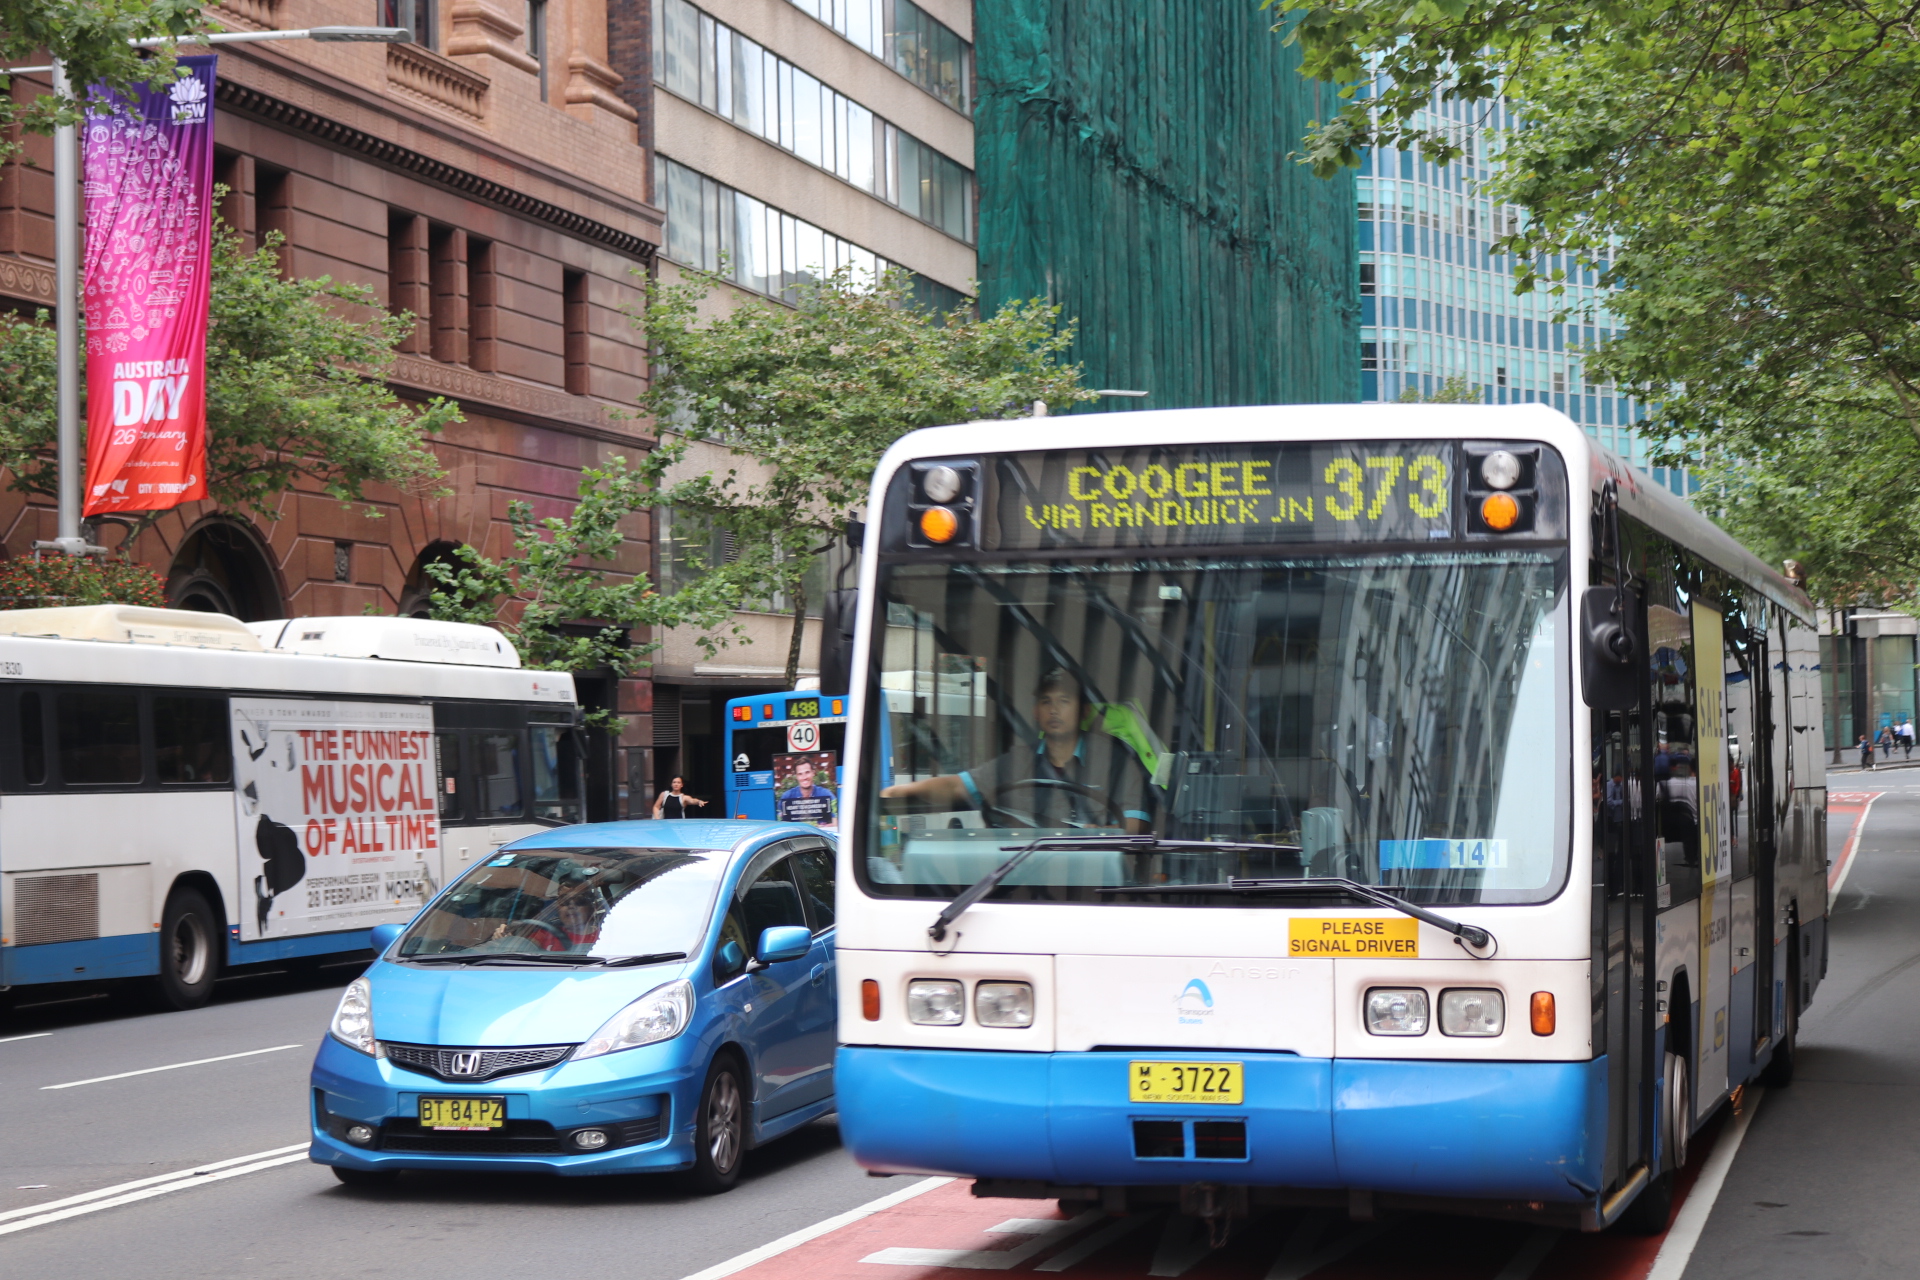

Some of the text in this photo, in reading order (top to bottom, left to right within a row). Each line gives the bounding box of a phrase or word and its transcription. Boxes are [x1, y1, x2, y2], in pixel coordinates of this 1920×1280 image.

[171, 102, 207, 120] NSW
[113, 358, 189, 379] AUSTRALIA
[113, 375, 189, 427] DAY
[113, 428, 136, 446] 26
[1068, 460, 1272, 501] COOGEE
[1324, 454, 1447, 522] 373
[1025, 496, 1313, 530] VIA RANDWICK JN
[789, 701, 819, 718] 438
[1700, 686, 1724, 738] SALE
[298, 729, 430, 761] THE FUNNIEST
[793, 727, 815, 743] 40
[301, 762, 435, 815] MUSICAL
[305, 814, 438, 857] OF ALL TIME
[1457, 841, 1500, 866] 141
[323, 884, 381, 906] FEBRUARY
[1322, 922, 1385, 936] PLEASE
[1290, 939, 1416, 953] SIGNAL DRIVER
[1207, 961, 1301, 980] Ansair
[1177, 1007, 1215, 1017] Transport
[1172, 1066, 1231, 1093] 3722
